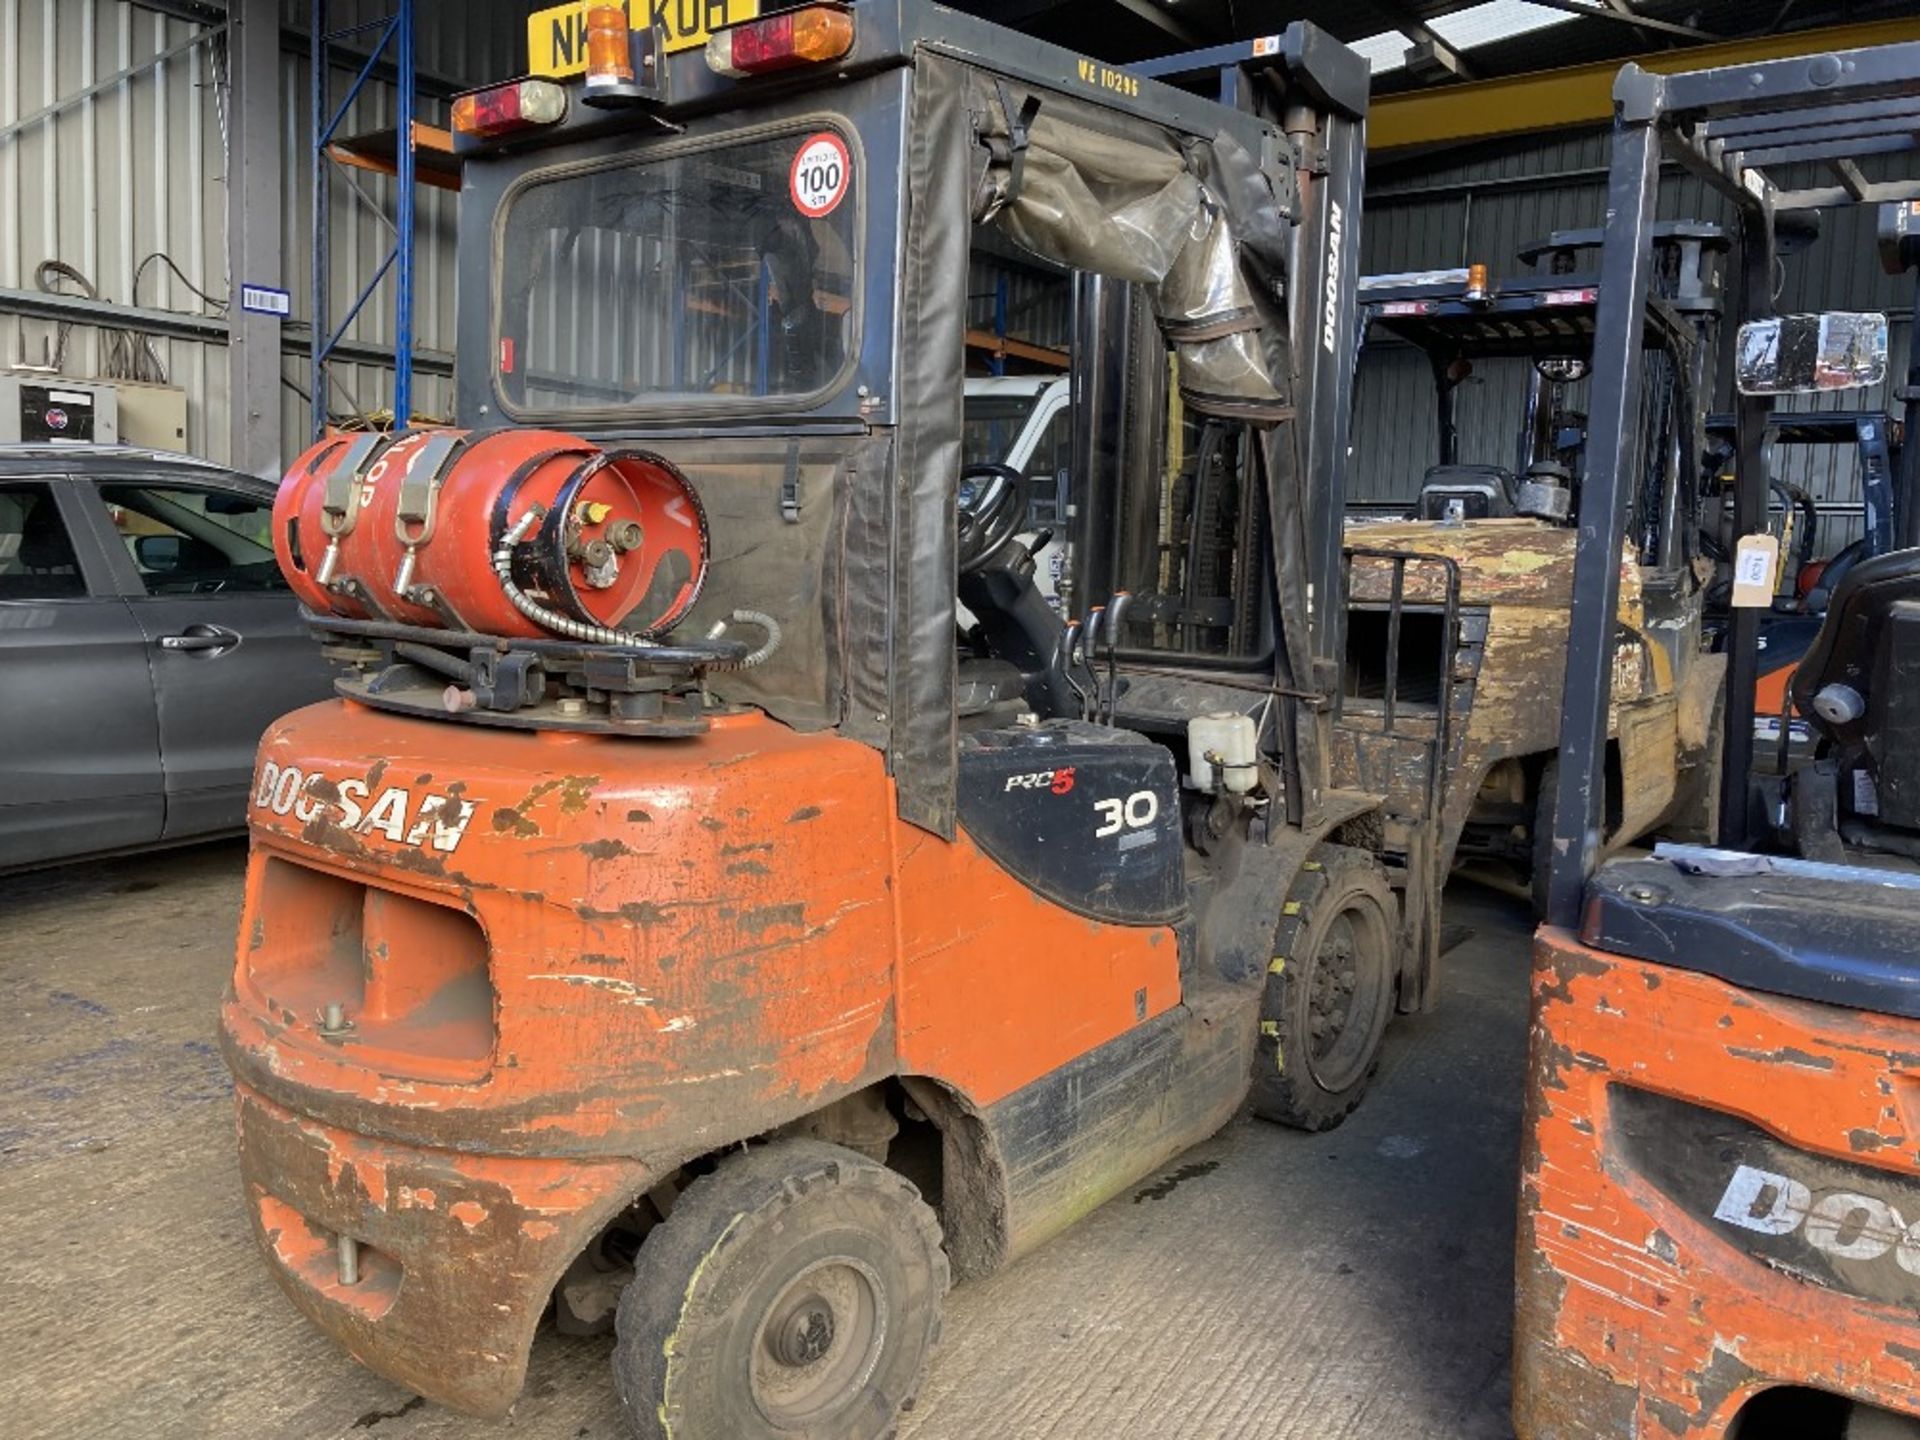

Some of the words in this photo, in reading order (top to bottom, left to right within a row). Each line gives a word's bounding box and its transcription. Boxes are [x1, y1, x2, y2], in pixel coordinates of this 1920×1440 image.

[800, 163, 839, 194] 100
[1324, 199, 1342, 354] DOOSAN
[256, 761, 475, 852] DOOSAN
[1094, 790, 1158, 838] 30
[1713, 1164, 1920, 1277] DO
